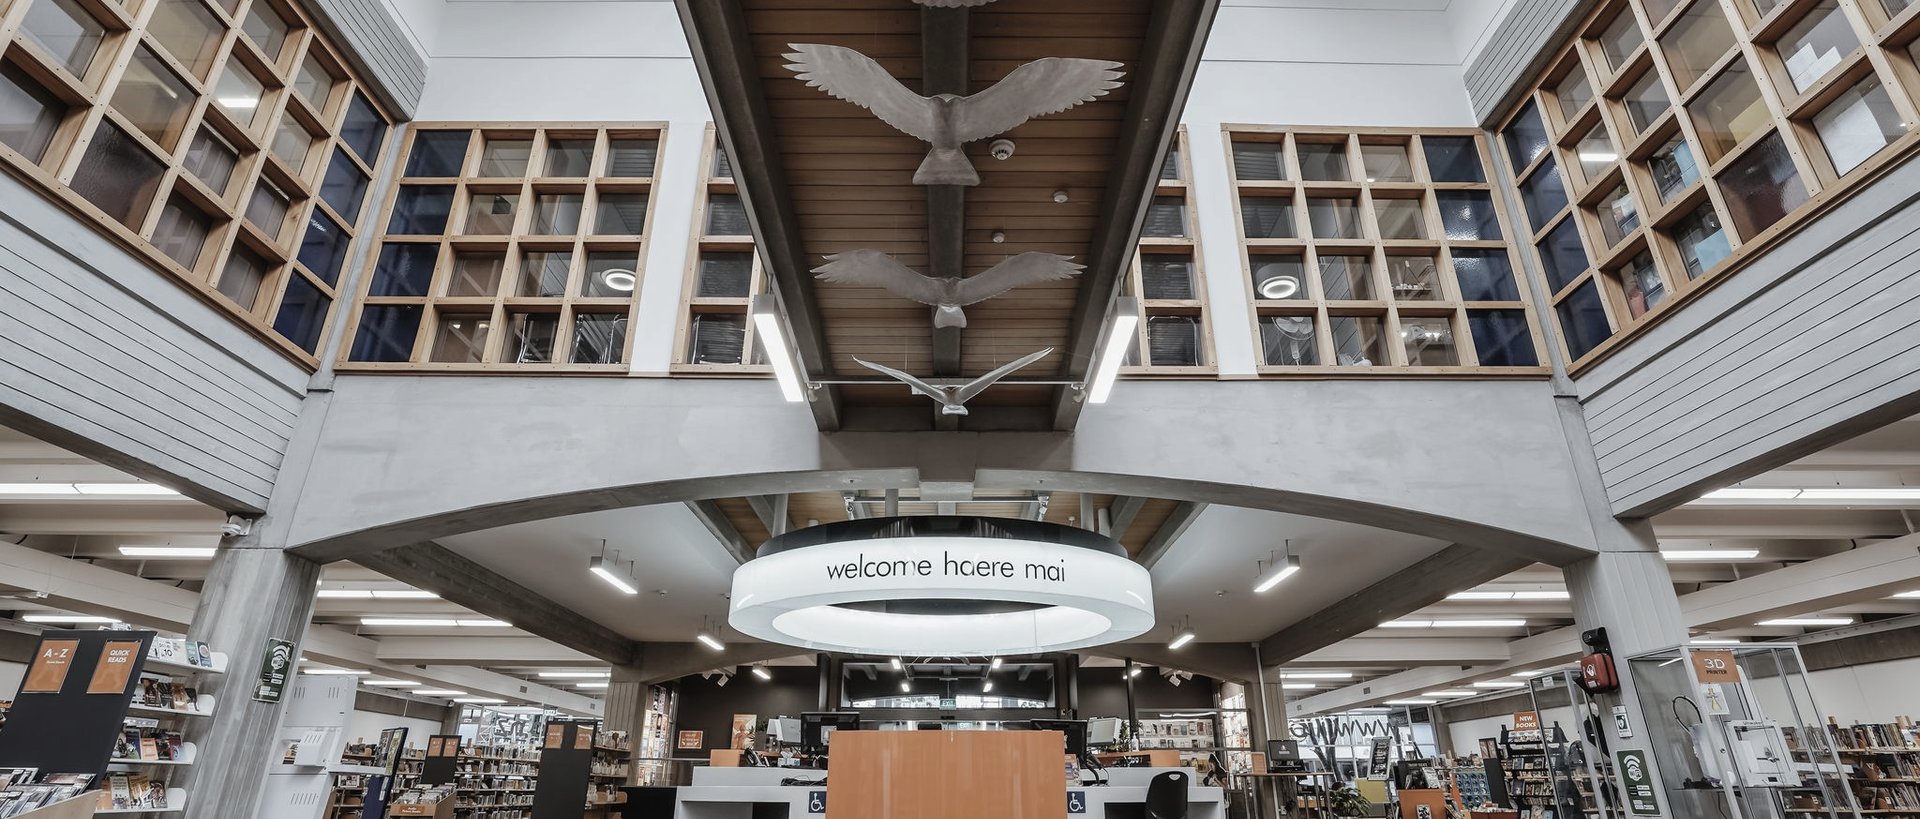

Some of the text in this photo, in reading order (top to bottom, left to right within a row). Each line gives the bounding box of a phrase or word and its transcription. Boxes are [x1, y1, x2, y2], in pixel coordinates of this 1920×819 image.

[827, 551, 1065, 582] welcome haere mai
[1704, 658, 1725, 669] 3D
